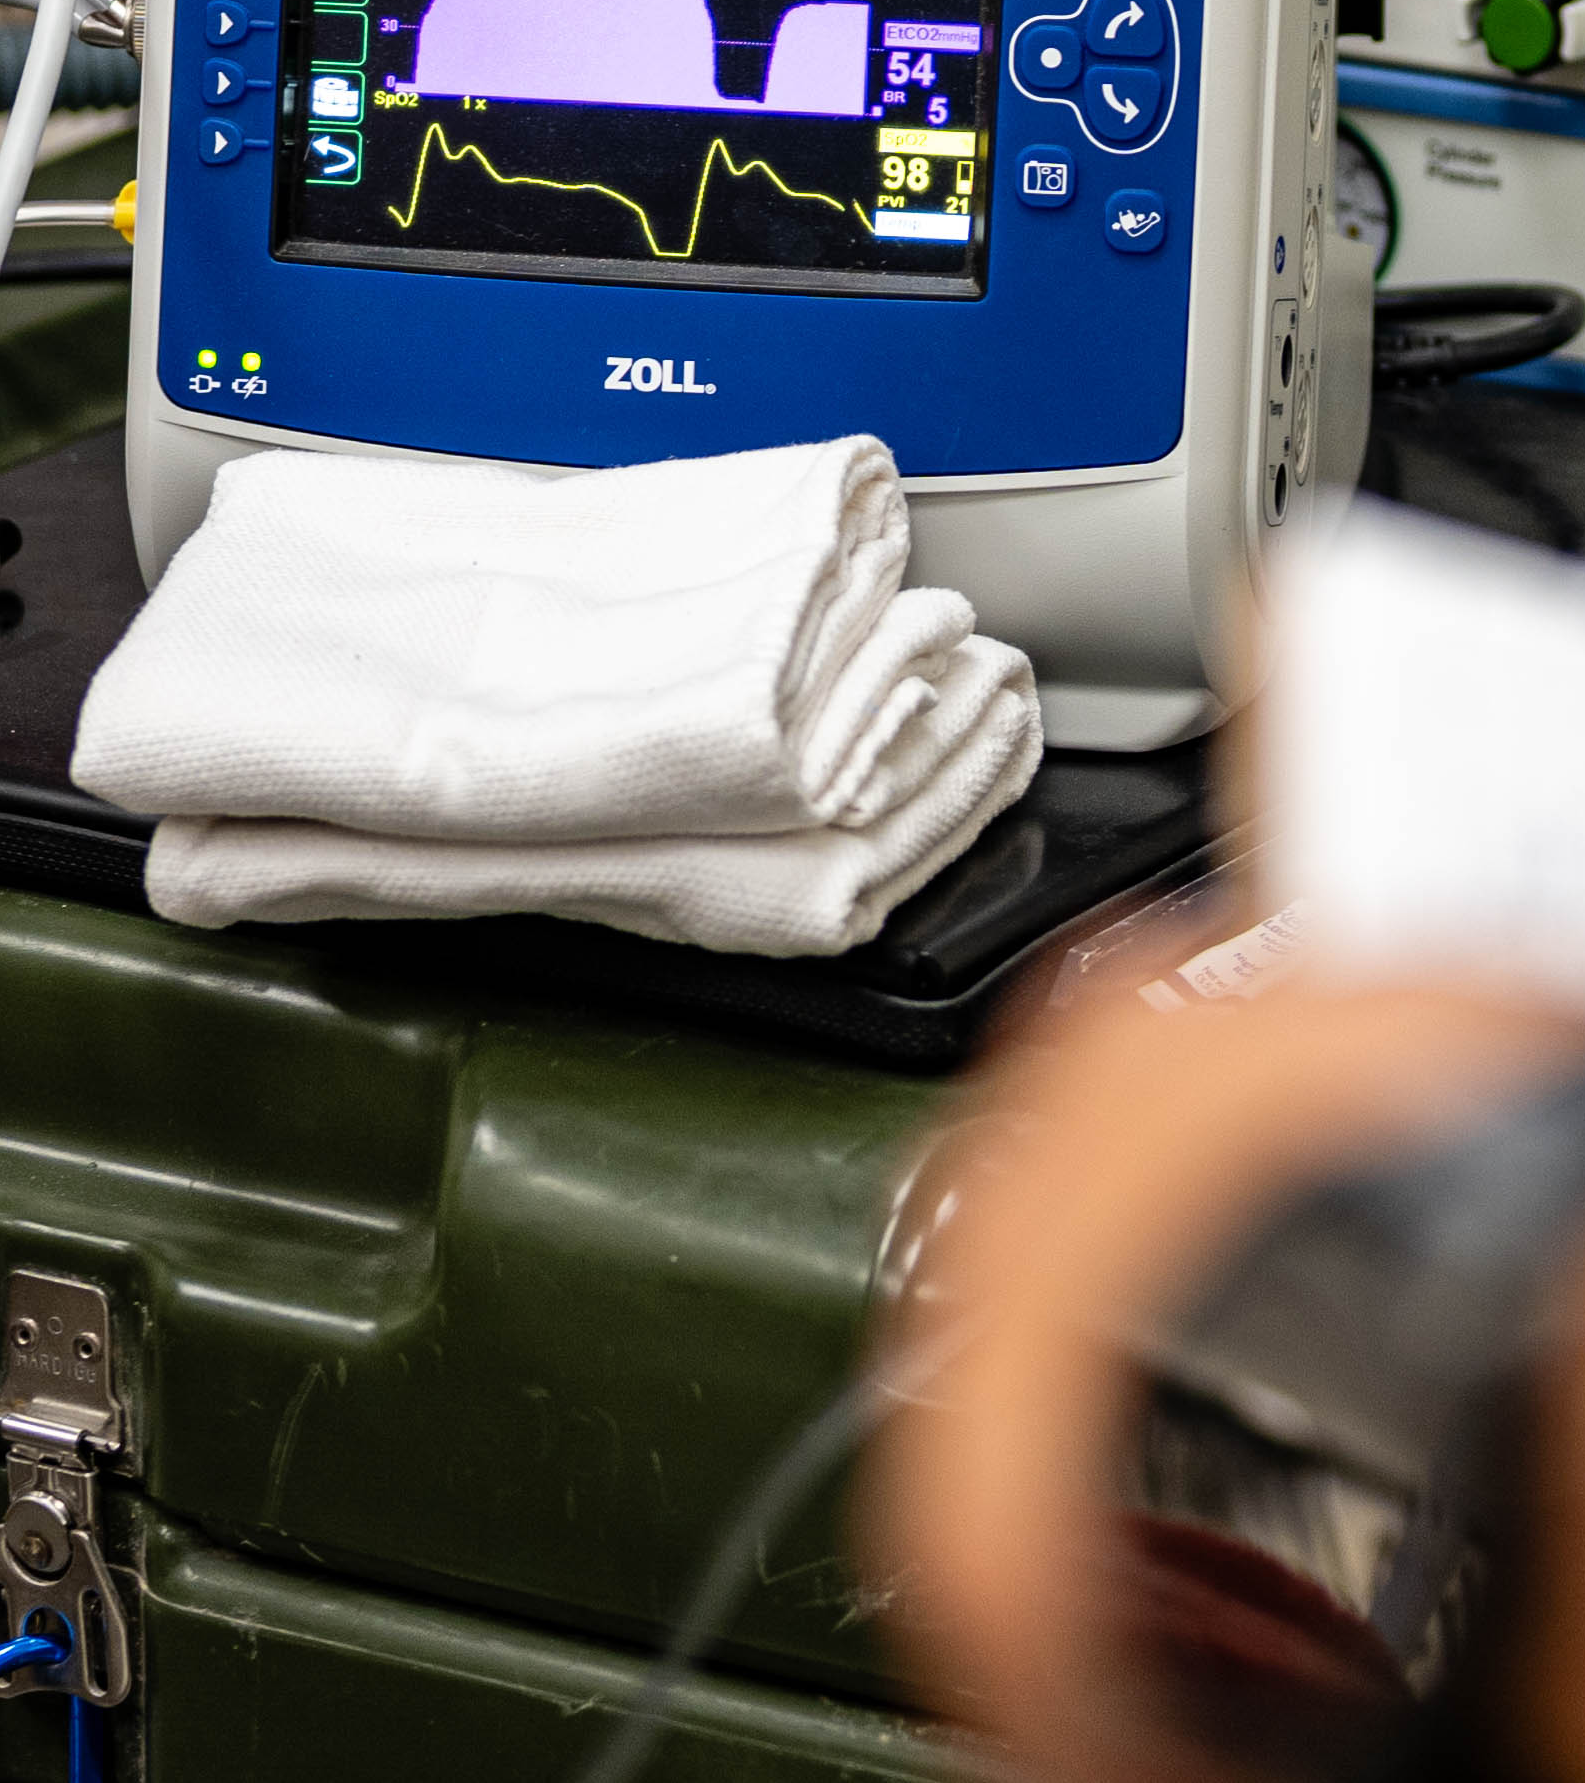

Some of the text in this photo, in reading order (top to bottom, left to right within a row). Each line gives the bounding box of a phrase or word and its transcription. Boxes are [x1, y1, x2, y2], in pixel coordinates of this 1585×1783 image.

[380, 18, 399, 33] 30
[886, 25, 939, 42] EtCO2
[887, 51, 936, 87] 54
[386, 74, 396, 87] 0
[374, 90, 419, 109] SpO2
[883, 90, 949, 125] BR 5
[884, 131, 928, 148] SpO2
[882, 155, 930, 192] 98
[877, 195, 969, 215] PVI 21
[603, 356, 705, 394] ZOLL
